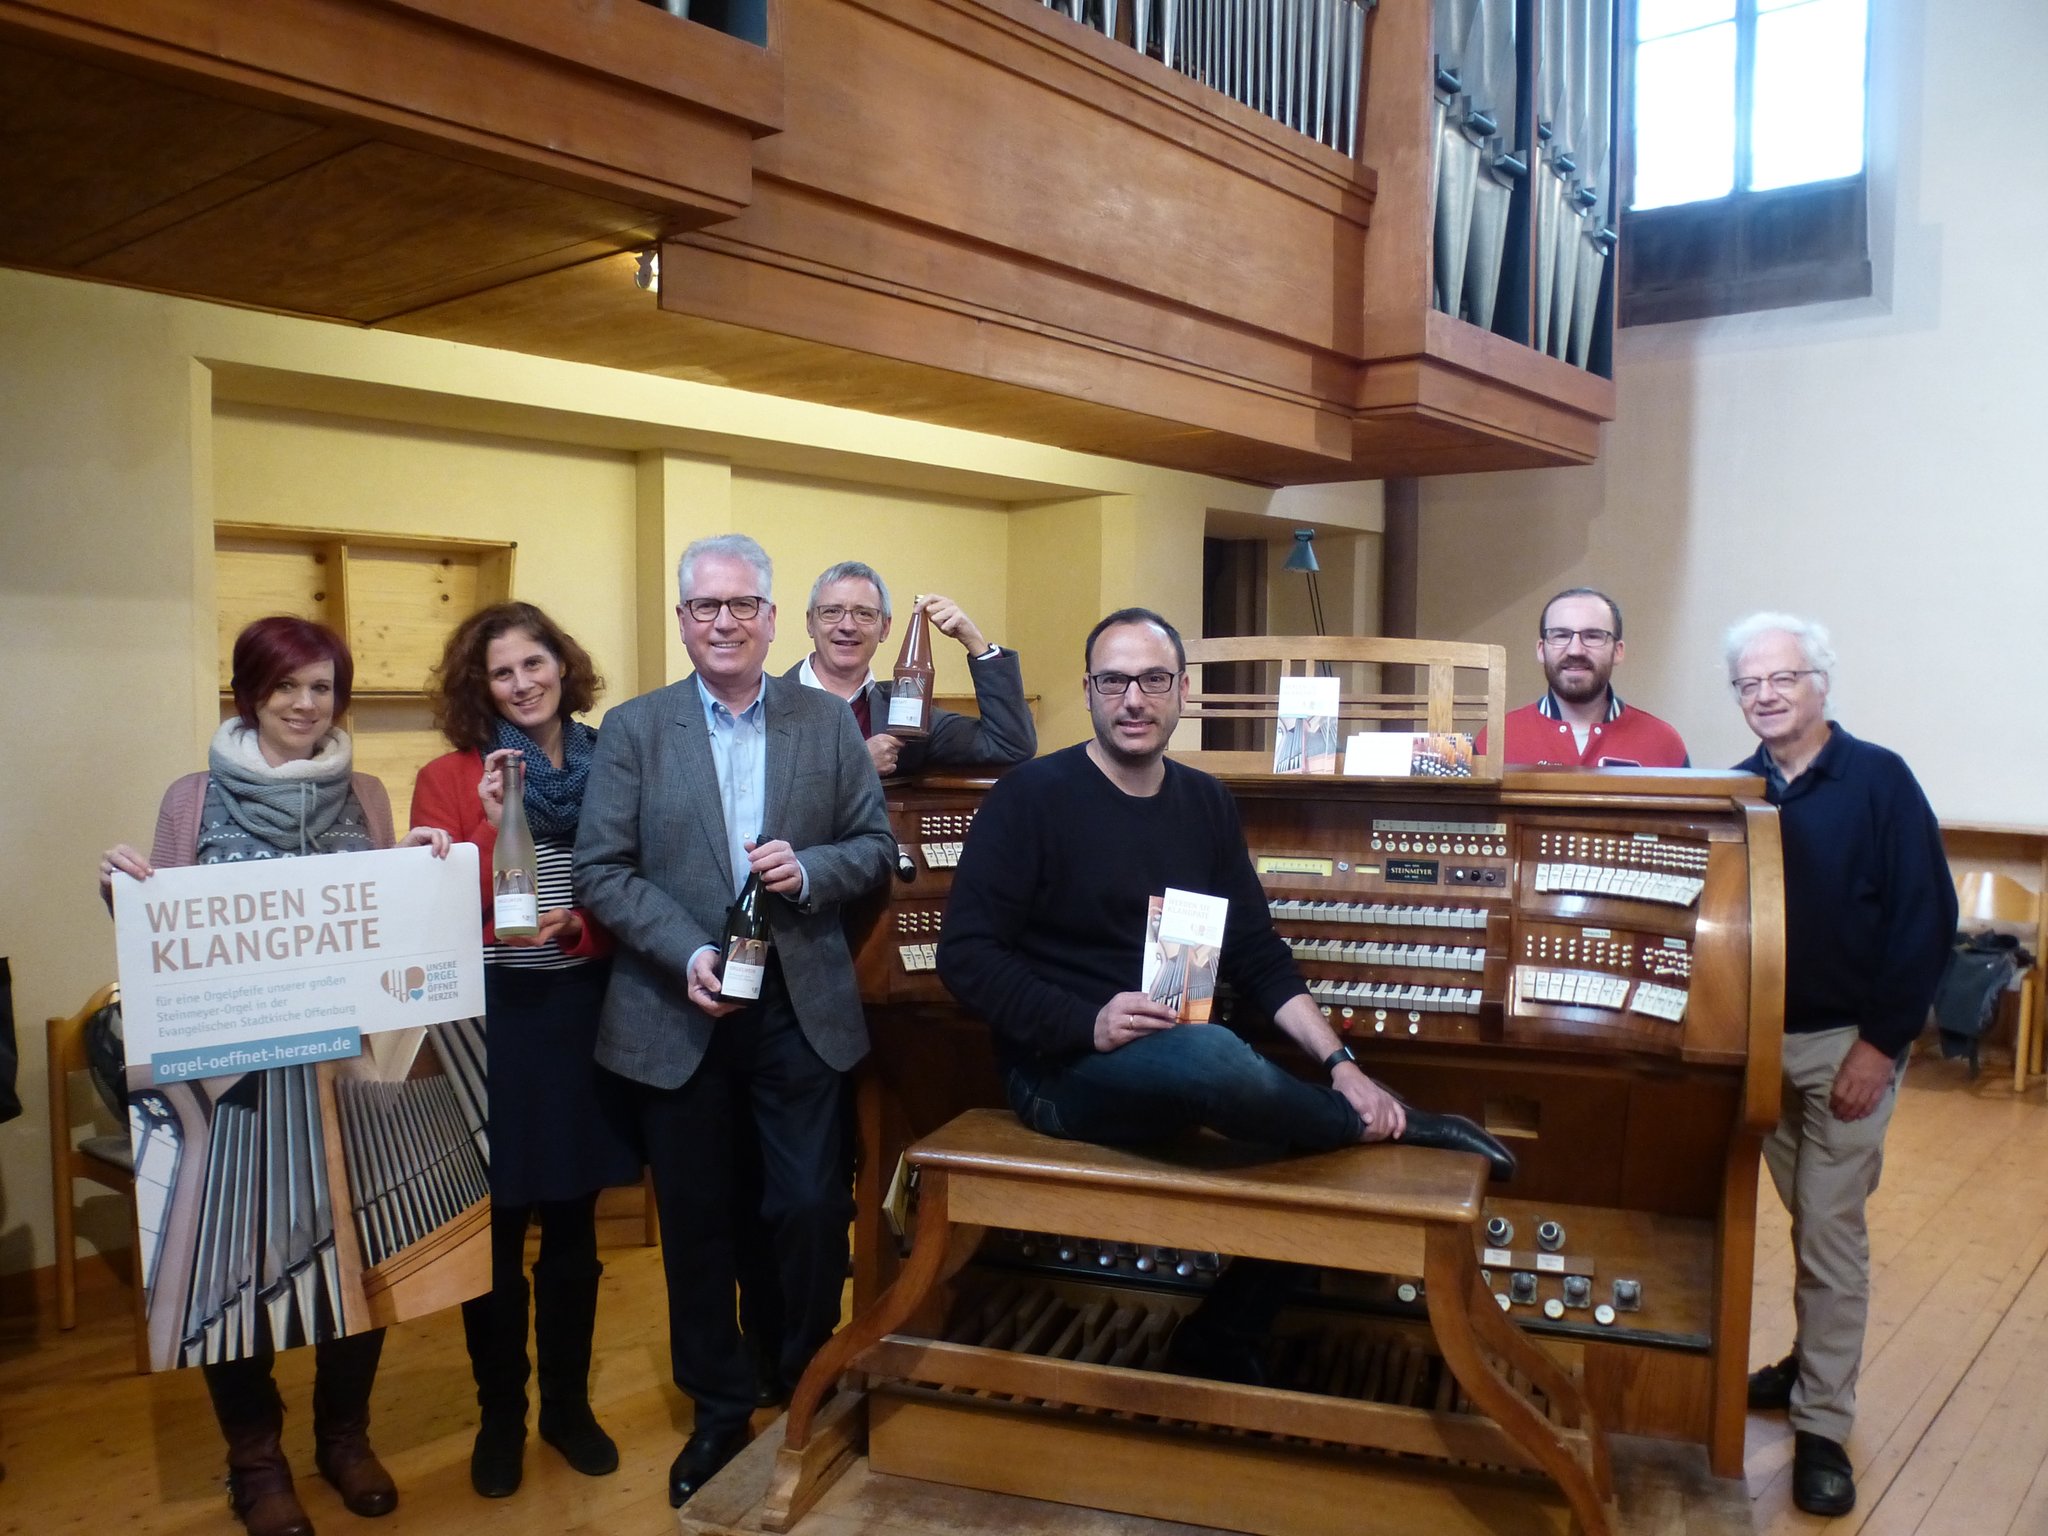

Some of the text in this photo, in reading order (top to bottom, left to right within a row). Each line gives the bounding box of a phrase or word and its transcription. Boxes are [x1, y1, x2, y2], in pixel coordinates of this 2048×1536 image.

[1390, 867, 1433, 875] STEINMEYER
[145, 881, 378, 933] WERDEN SIE
[151, 917, 380, 973] KLANGPATE
[427, 960, 458, 971] UNSERE
[427, 970, 458, 982] ORGEL
[156, 975, 346, 1007] für eine Orgelpfeife unserer großen
[428, 991, 459, 1002] HERZEN
[157, 997, 288, 1023] Steinmeyer-Orgel in der
[158, 1004, 356, 1038] Evangelischen Stadtkirche Offenburg
[159, 1036, 351, 1077] orgel-oeffnet-herzen.de
